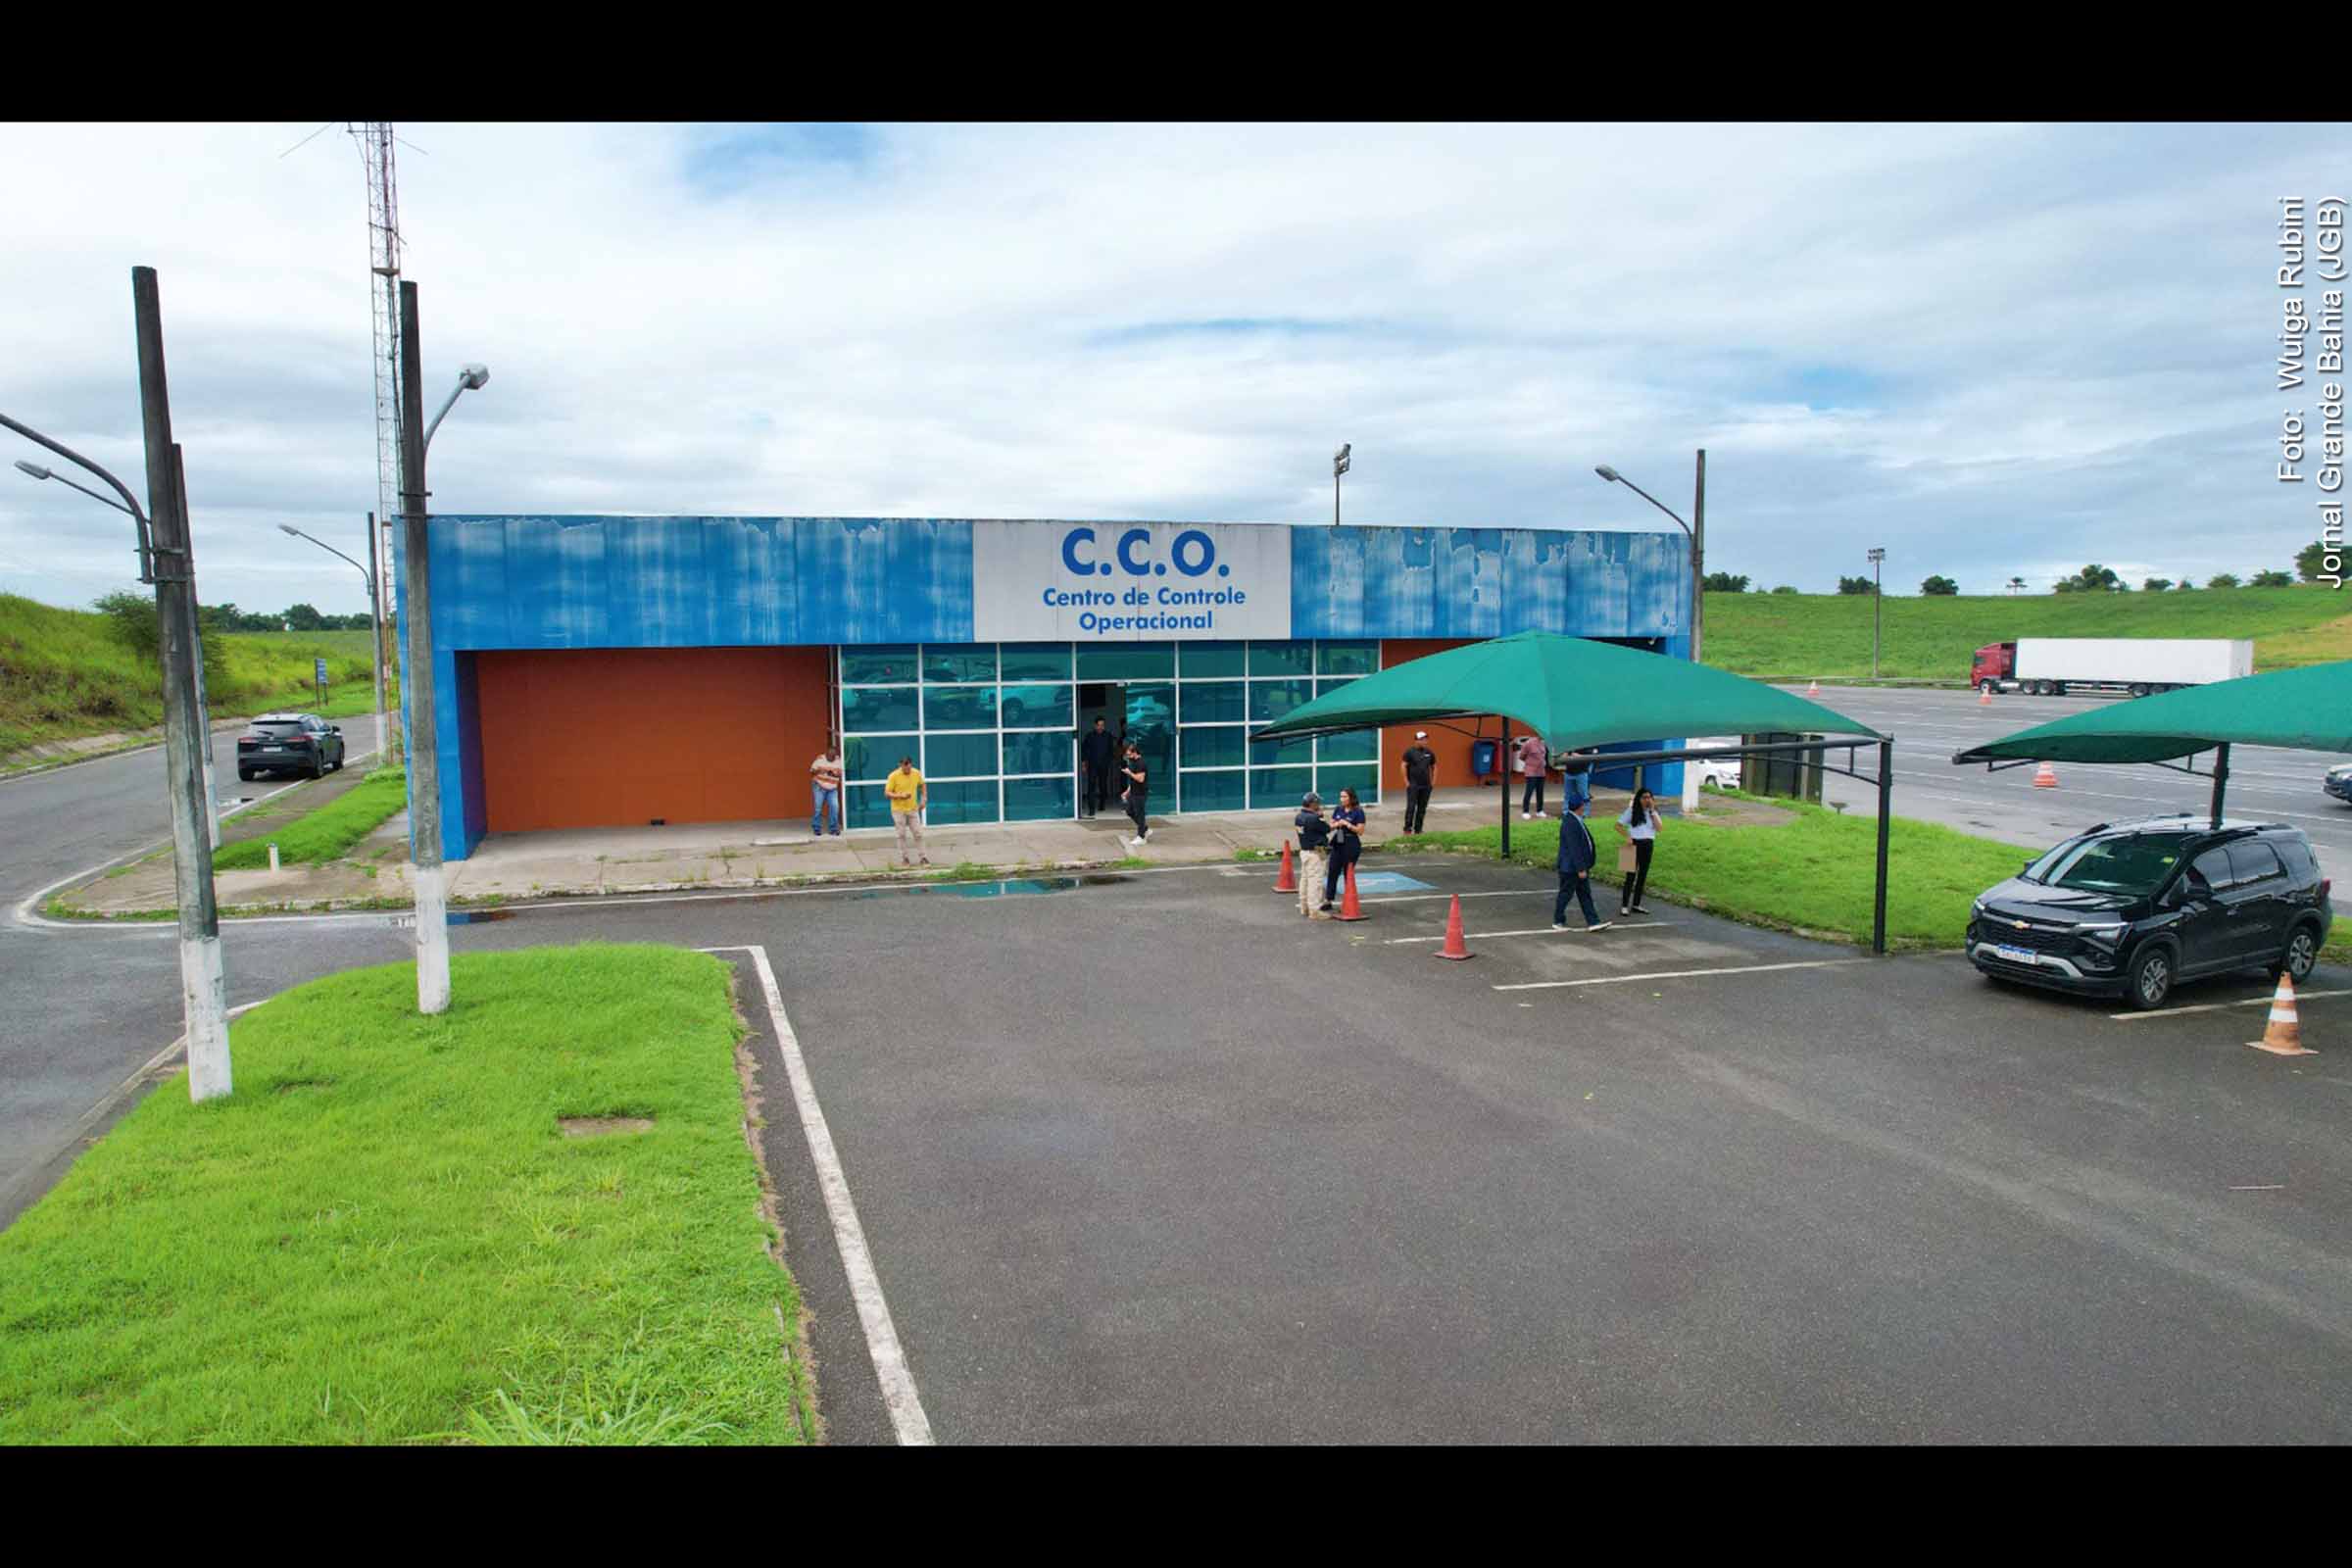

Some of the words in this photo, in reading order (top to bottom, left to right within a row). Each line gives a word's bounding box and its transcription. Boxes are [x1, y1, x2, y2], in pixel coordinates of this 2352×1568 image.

[1061, 527, 1230, 576] C.C.O.
[1043, 587, 1115, 606] Centro
[1123, 587, 1150, 605] de
[1156, 587, 1246, 605] Controle
[1079, 611, 1213, 634] Operacional
